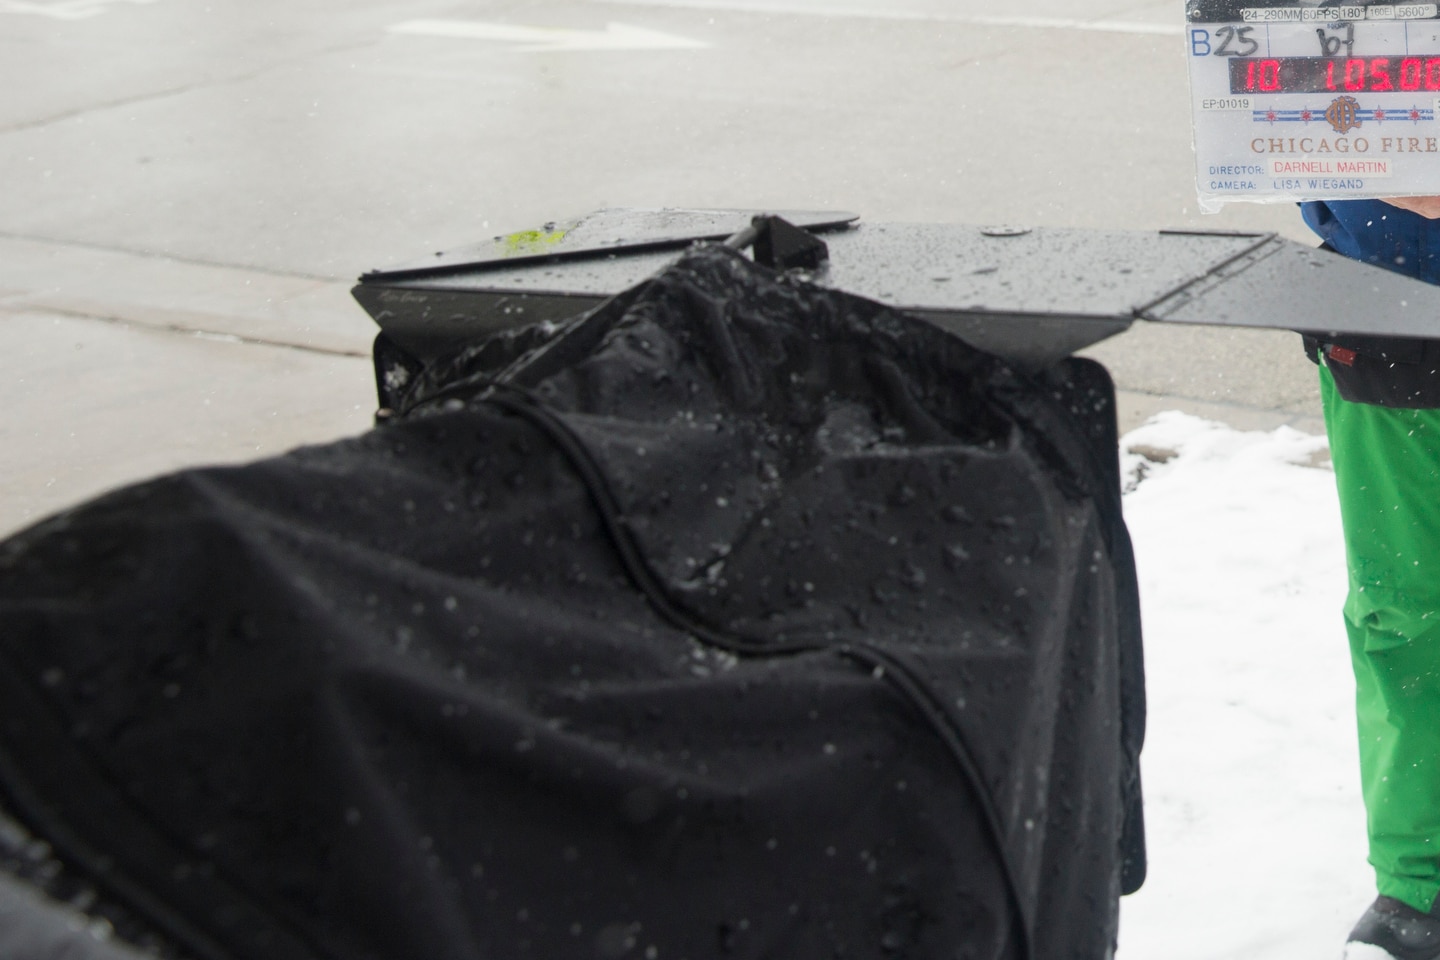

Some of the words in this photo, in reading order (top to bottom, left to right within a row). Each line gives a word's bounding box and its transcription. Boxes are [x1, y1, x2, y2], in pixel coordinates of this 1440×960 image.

[1244, 9, 1302, 20] 24-290MM
[1303, 9, 1339, 20] 60FPS
[1191, 29, 1211, 56] B
[1213, 26, 1259, 57] 25
[1202, 99, 1249, 109] EP:01019
[1250, 137, 1370, 154] CHICAGO
[1381, 137, 1438, 153] FIRE
[1209, 165, 1265, 175] DIRECTOR:
[1274, 161, 1333, 173] DARNELL
[1336, 161, 1388, 173] MARTIN
[1210, 180, 1257, 190] CAMERA:
[1273, 179, 1302, 190] LISA
[1307, 178, 1364, 190] WIEGAND
